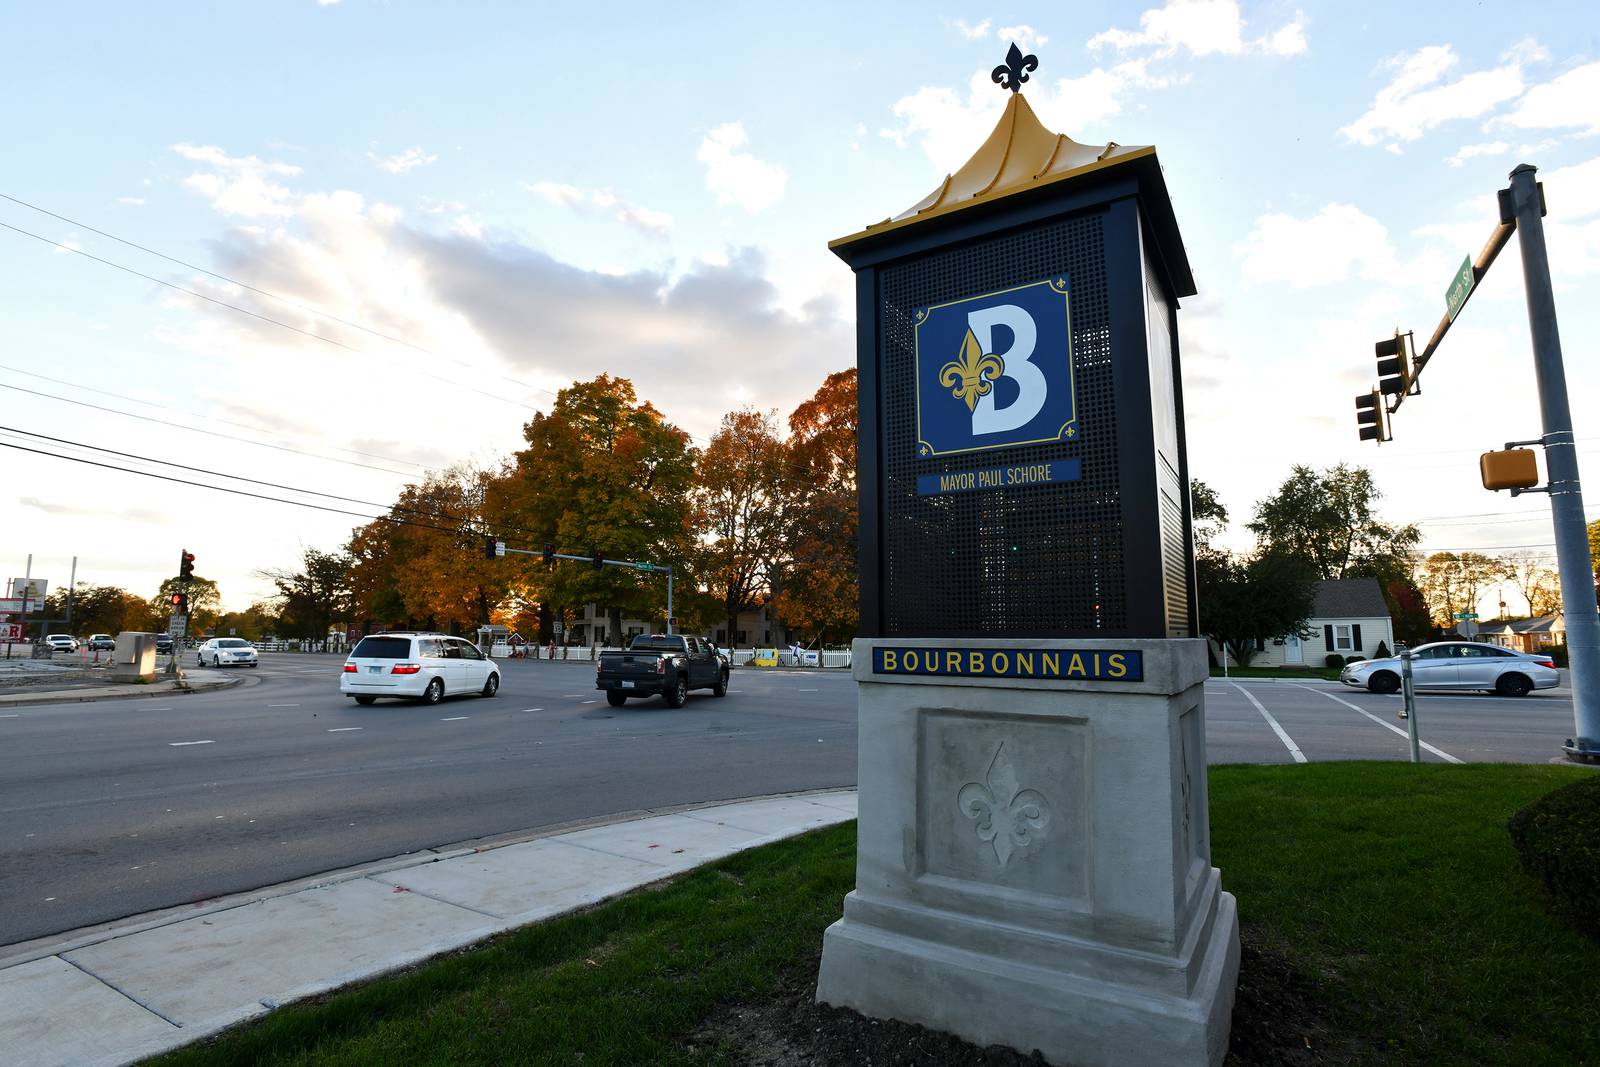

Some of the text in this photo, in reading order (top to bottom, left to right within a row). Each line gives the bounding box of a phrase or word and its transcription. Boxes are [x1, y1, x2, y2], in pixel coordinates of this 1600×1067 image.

[968, 304, 1048, 436] B
[940, 464, 1052, 492] MAYOR PAUL SCHORE
[883, 650, 1127, 677] BOURBONNAIS
